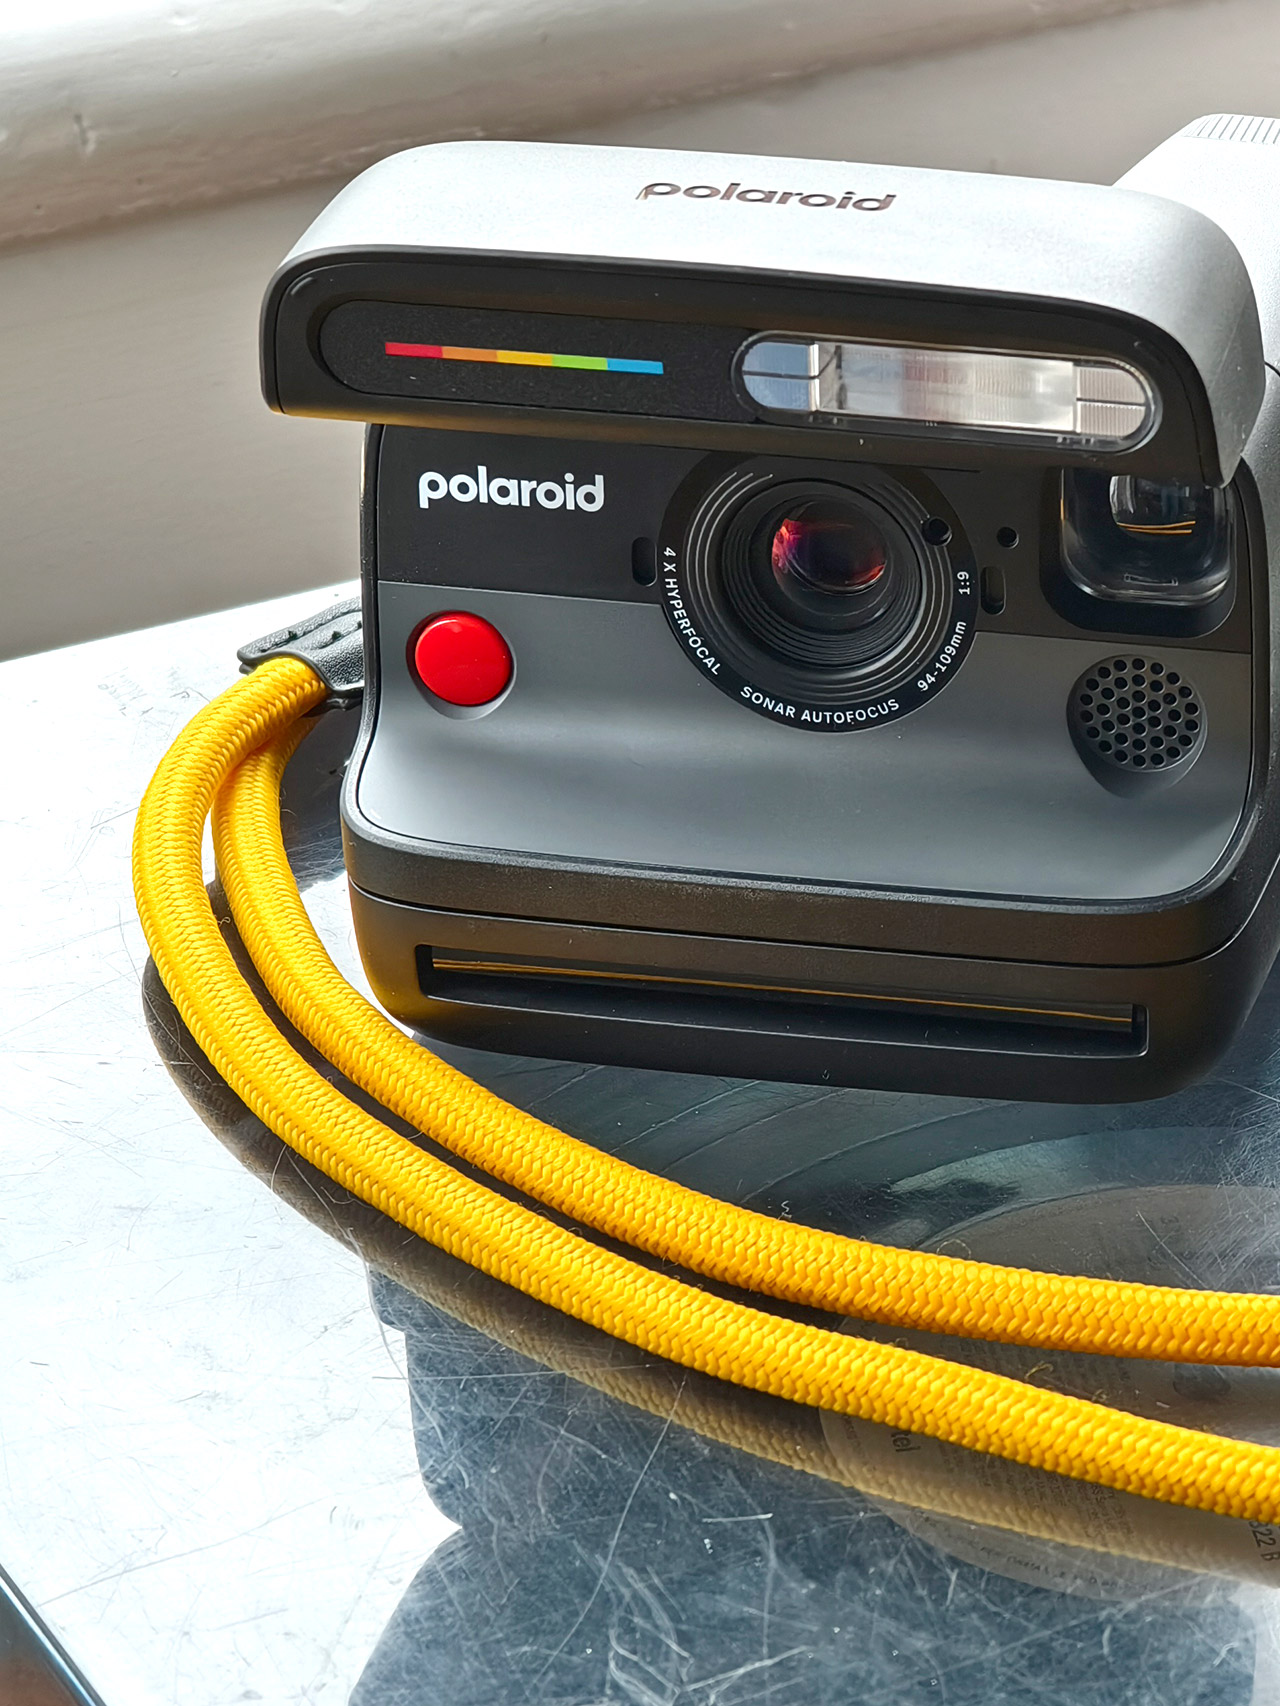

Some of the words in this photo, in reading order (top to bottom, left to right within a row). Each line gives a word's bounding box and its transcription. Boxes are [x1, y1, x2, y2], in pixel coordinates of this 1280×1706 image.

[635, 182, 897, 212] polaroid
[418, 464, 605, 513] polaroid
[662, 546, 677, 558] 4
[662, 560, 677, 573] X
[956, 570, 971, 596] 1:9
[663, 577, 721, 676] HYPERFOCAL
[917, 620, 968, 692] 94-109mm
[740, 685, 796, 719] SONAR
[800, 698, 900, 725] AUTOFOCUS
